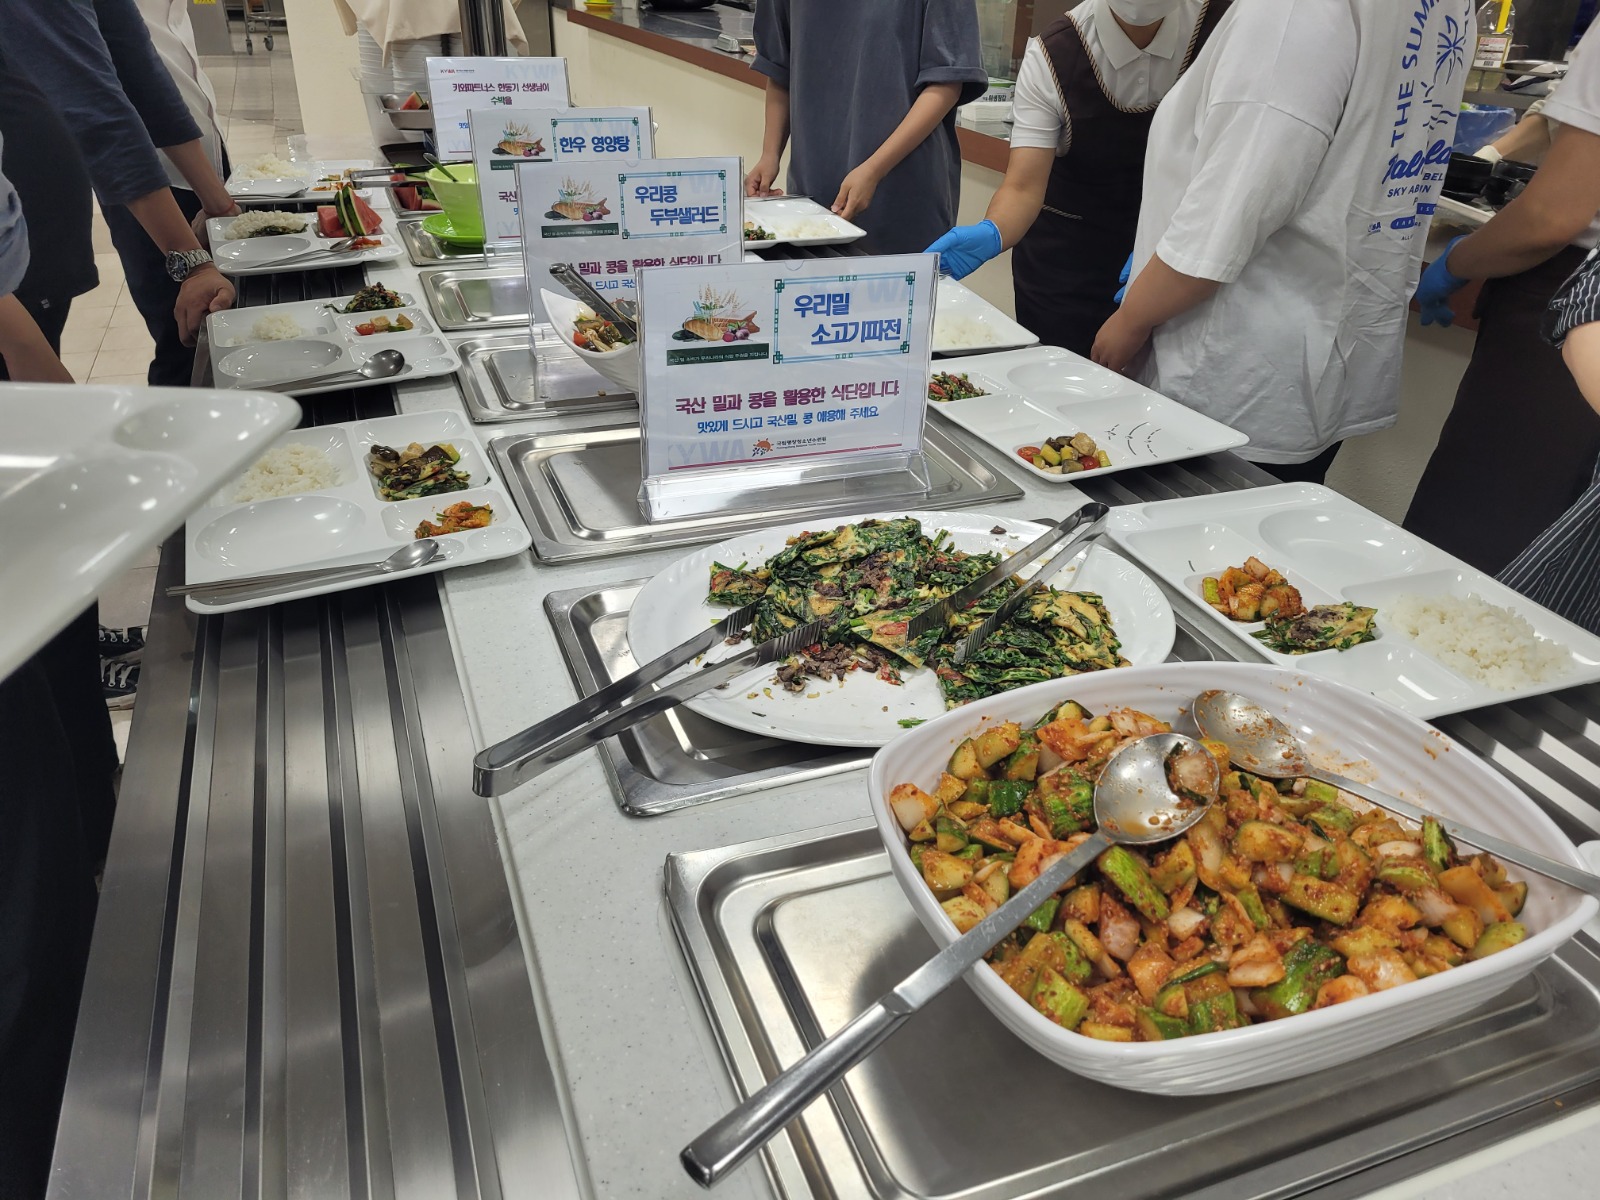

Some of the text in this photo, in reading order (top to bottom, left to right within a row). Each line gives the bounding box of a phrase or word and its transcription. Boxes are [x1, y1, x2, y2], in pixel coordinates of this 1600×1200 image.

[522, 83, 549, 92] 선생님이
[1390, 80, 1415, 148] THE
[559, 135, 630, 153] 한우 영양탕
[635, 185, 678, 204] 우리콩
[650, 206, 719, 226] 두부샐러드
[579, 262, 602, 275] 밀과
[606, 260, 629, 275] 콩을
[793, 292, 850, 318] 우리밀
[811, 318, 902, 345] 소고기파전
[675, 396, 706, 414] 국산
[712, 393, 742, 412] 밀과
[748, 390, 777, 409] 콩을
[783, 386, 826, 406] 활용한
[697, 419, 729, 434] 맛있게
[732, 416, 763, 430] 드시고
[803, 412, 813, 425] 콩
[817, 408, 846, 422] 애용해
